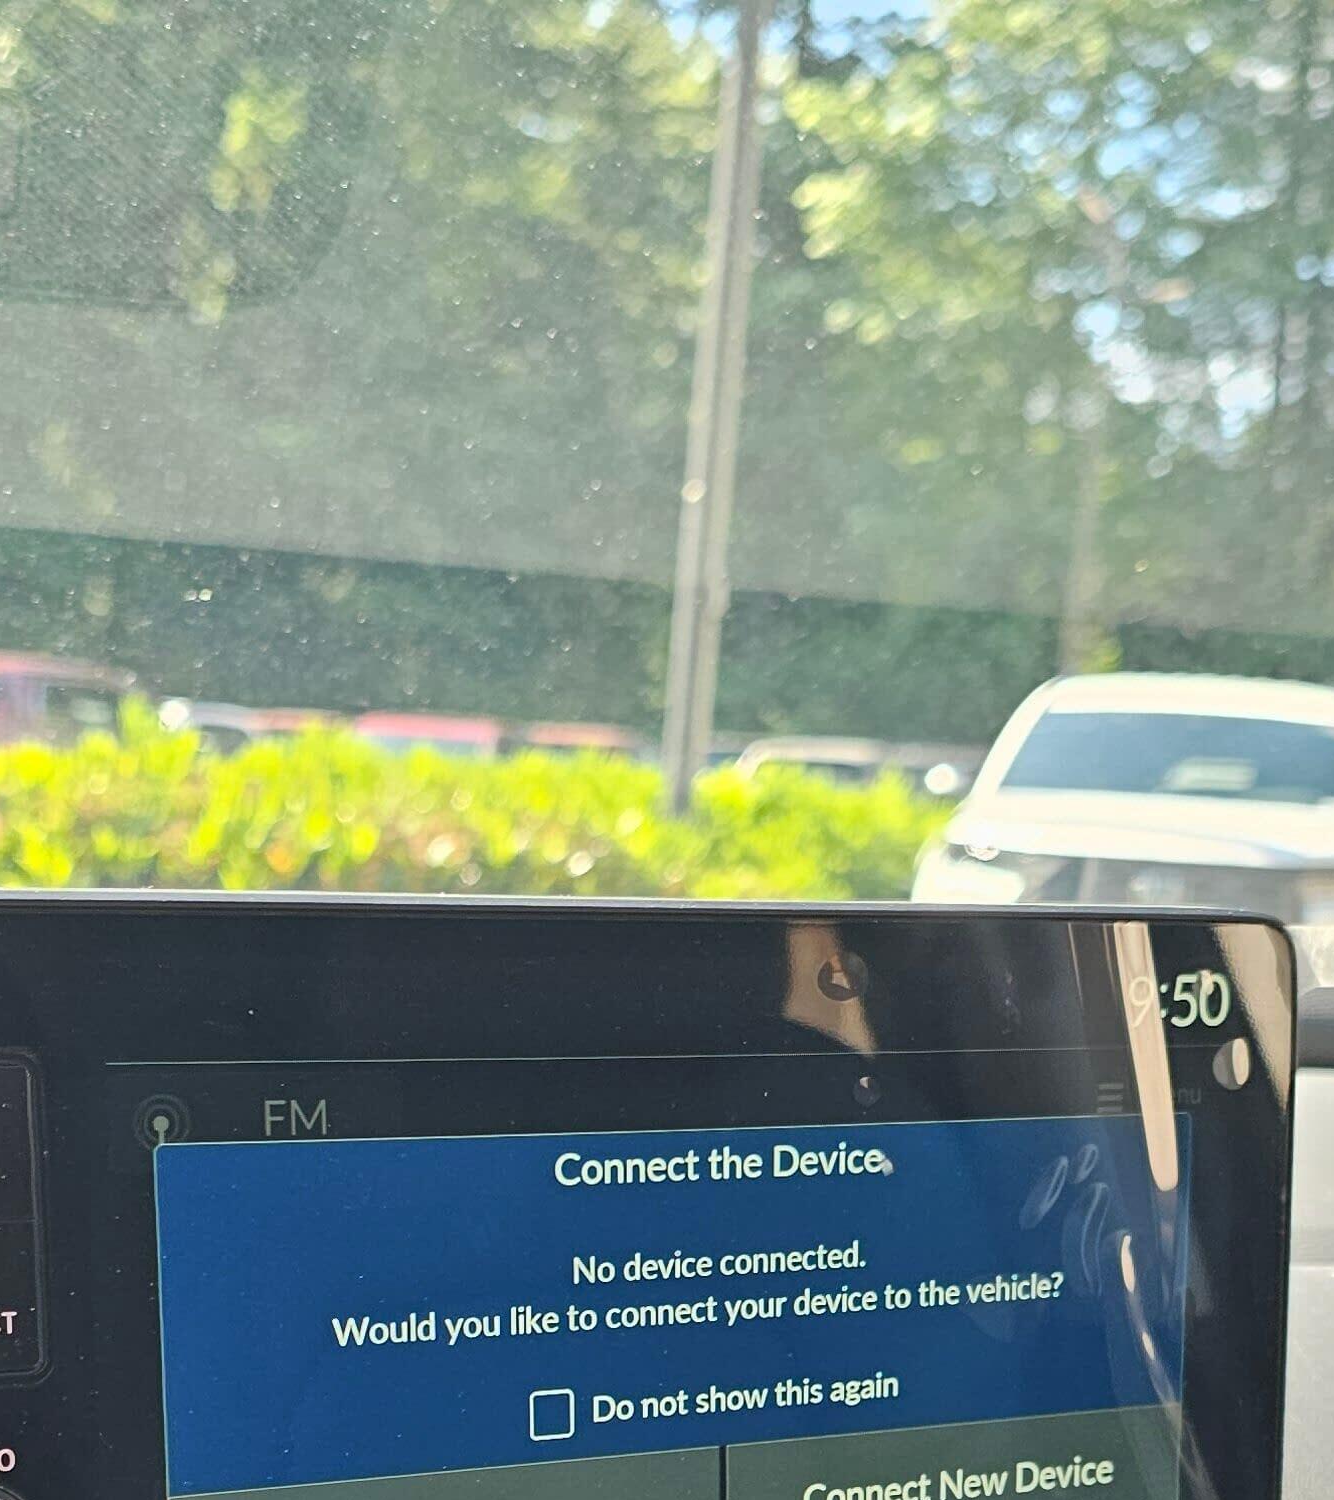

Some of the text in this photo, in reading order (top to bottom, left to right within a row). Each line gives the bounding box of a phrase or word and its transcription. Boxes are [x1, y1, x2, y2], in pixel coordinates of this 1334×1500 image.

[1128, 970, 1231, 1028] 9:50
[264, 1098, 327, 1137] FM
[555, 1141, 886, 1186] Connect the Device
[572, 1240, 867, 1285] No device connected.
[331, 1271, 1065, 1347] Would you like to connect your device to the vehicle?
[592, 1371, 899, 1423] Do not show this again
[1015, 1455, 1115, 1494] Device
